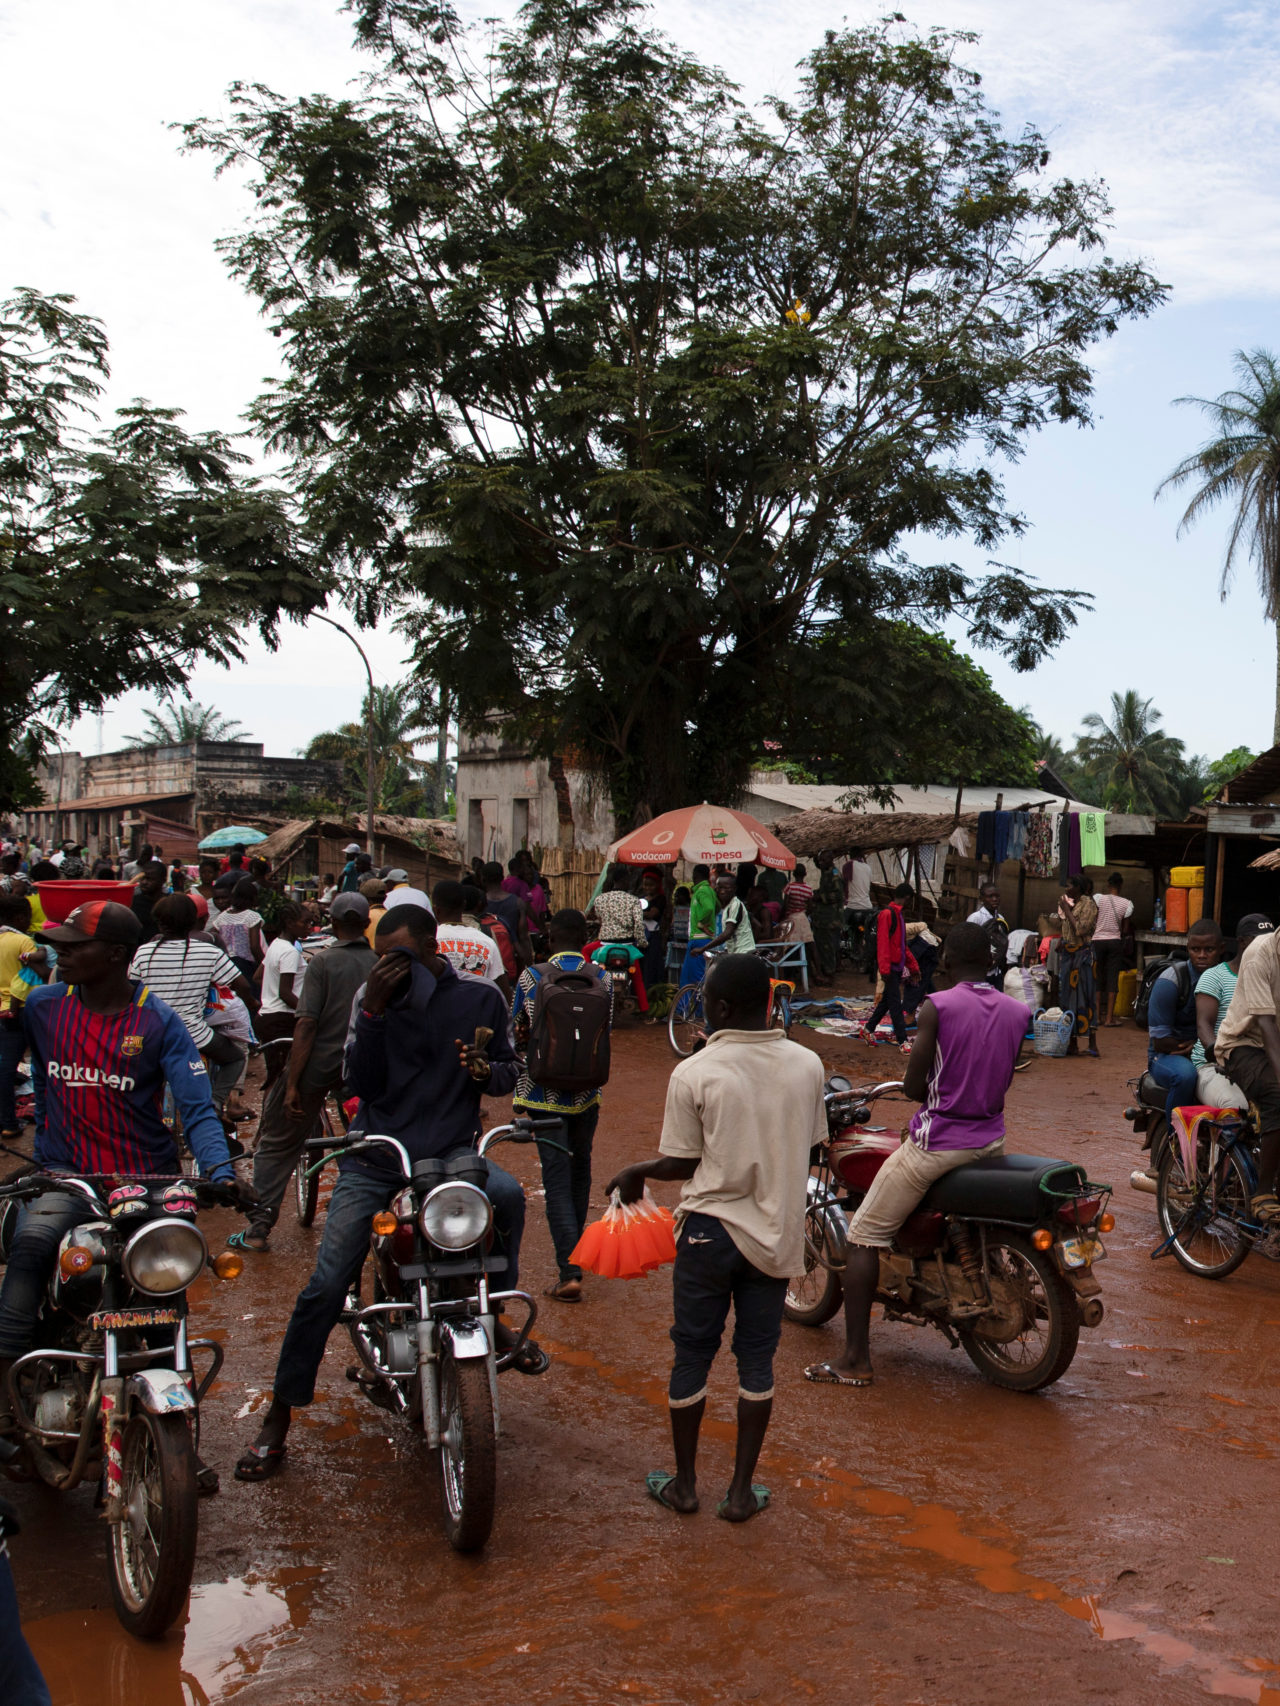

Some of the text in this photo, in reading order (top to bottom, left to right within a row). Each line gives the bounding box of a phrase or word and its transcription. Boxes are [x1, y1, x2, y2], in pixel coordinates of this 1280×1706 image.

[631, 851, 672, 861] vodacom
[701, 850, 742, 861] m-pesa
[48, 1061, 135, 1092] Rakuten
